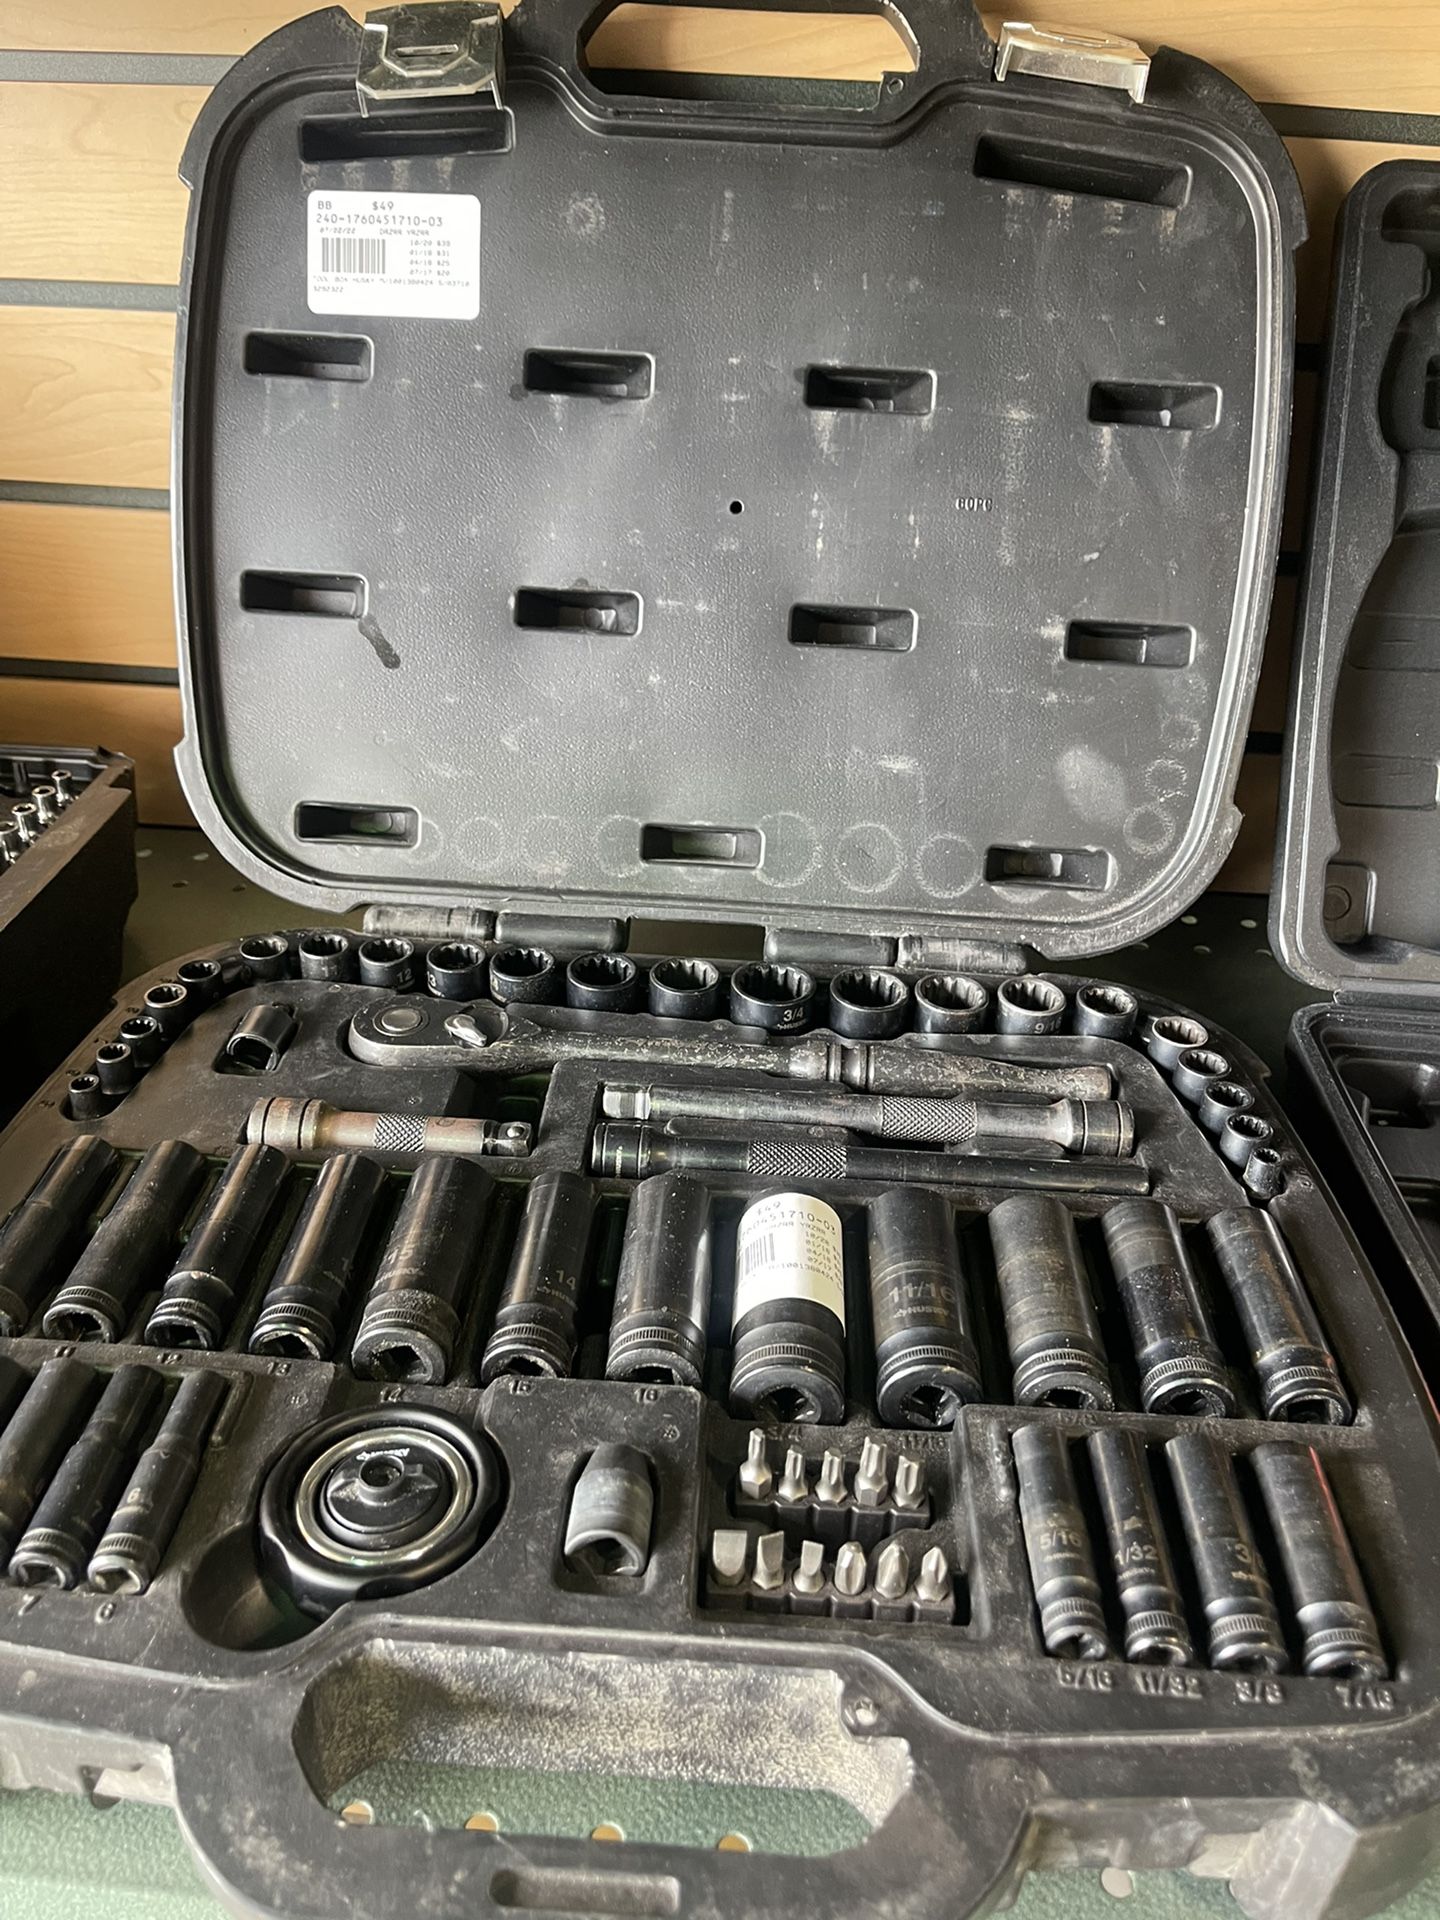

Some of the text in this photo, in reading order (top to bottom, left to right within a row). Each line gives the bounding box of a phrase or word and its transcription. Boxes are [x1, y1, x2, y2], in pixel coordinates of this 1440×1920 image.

[317, 200, 394, 211] BB $49
[316, 213, 443, 227] 240-1760451710-03
[783, 1006, 804, 1022] 3/4
[388, 1242, 416, 1264] 15
[555, 1270, 577, 1291] 14
[889, 1282, 957, 1303] 11/16
[907, 1304, 950, 1317] HUSKY
[127, 1487, 142, 1504] 6
[1039, 1529, 1083, 1550] 5/16
[1057, 1664, 1113, 1694] 5/16
[1133, 1670, 1203, 1700] 11/32
[1334, 1683, 1395, 1712] 7/16
